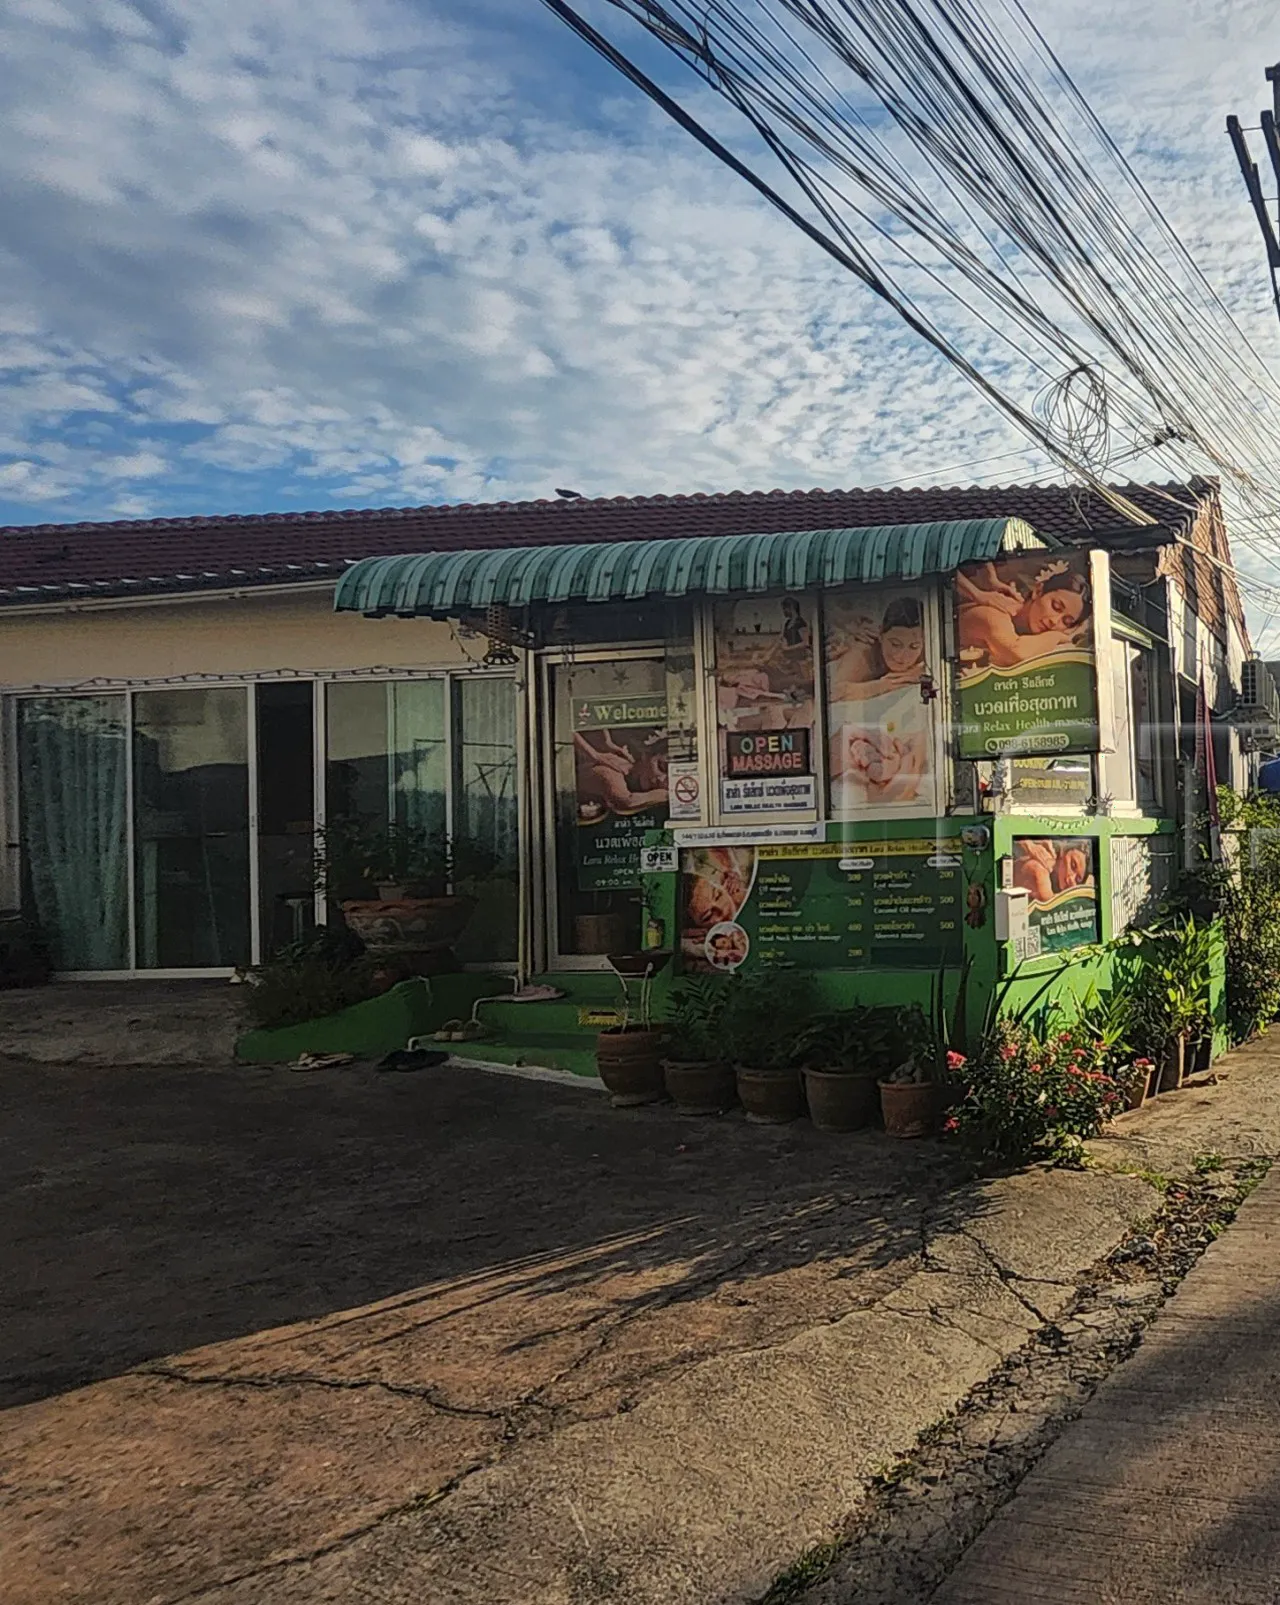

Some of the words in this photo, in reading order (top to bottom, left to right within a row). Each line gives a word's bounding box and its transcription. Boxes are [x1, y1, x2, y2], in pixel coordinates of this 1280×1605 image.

[974, 692, 1078, 716] นวดเพื่อสุขภาพ
[594, 704, 667, 720] Welcome
[983, 722, 1011, 733] Relax
[1016, 718, 1050, 730] Health
[740, 735, 793, 754] OPEN
[732, 752, 802, 771] MASSAGE
[647, 852, 672, 862] OPEN
[940, 896, 955, 904] 500
[940, 921, 955, 929] 500
